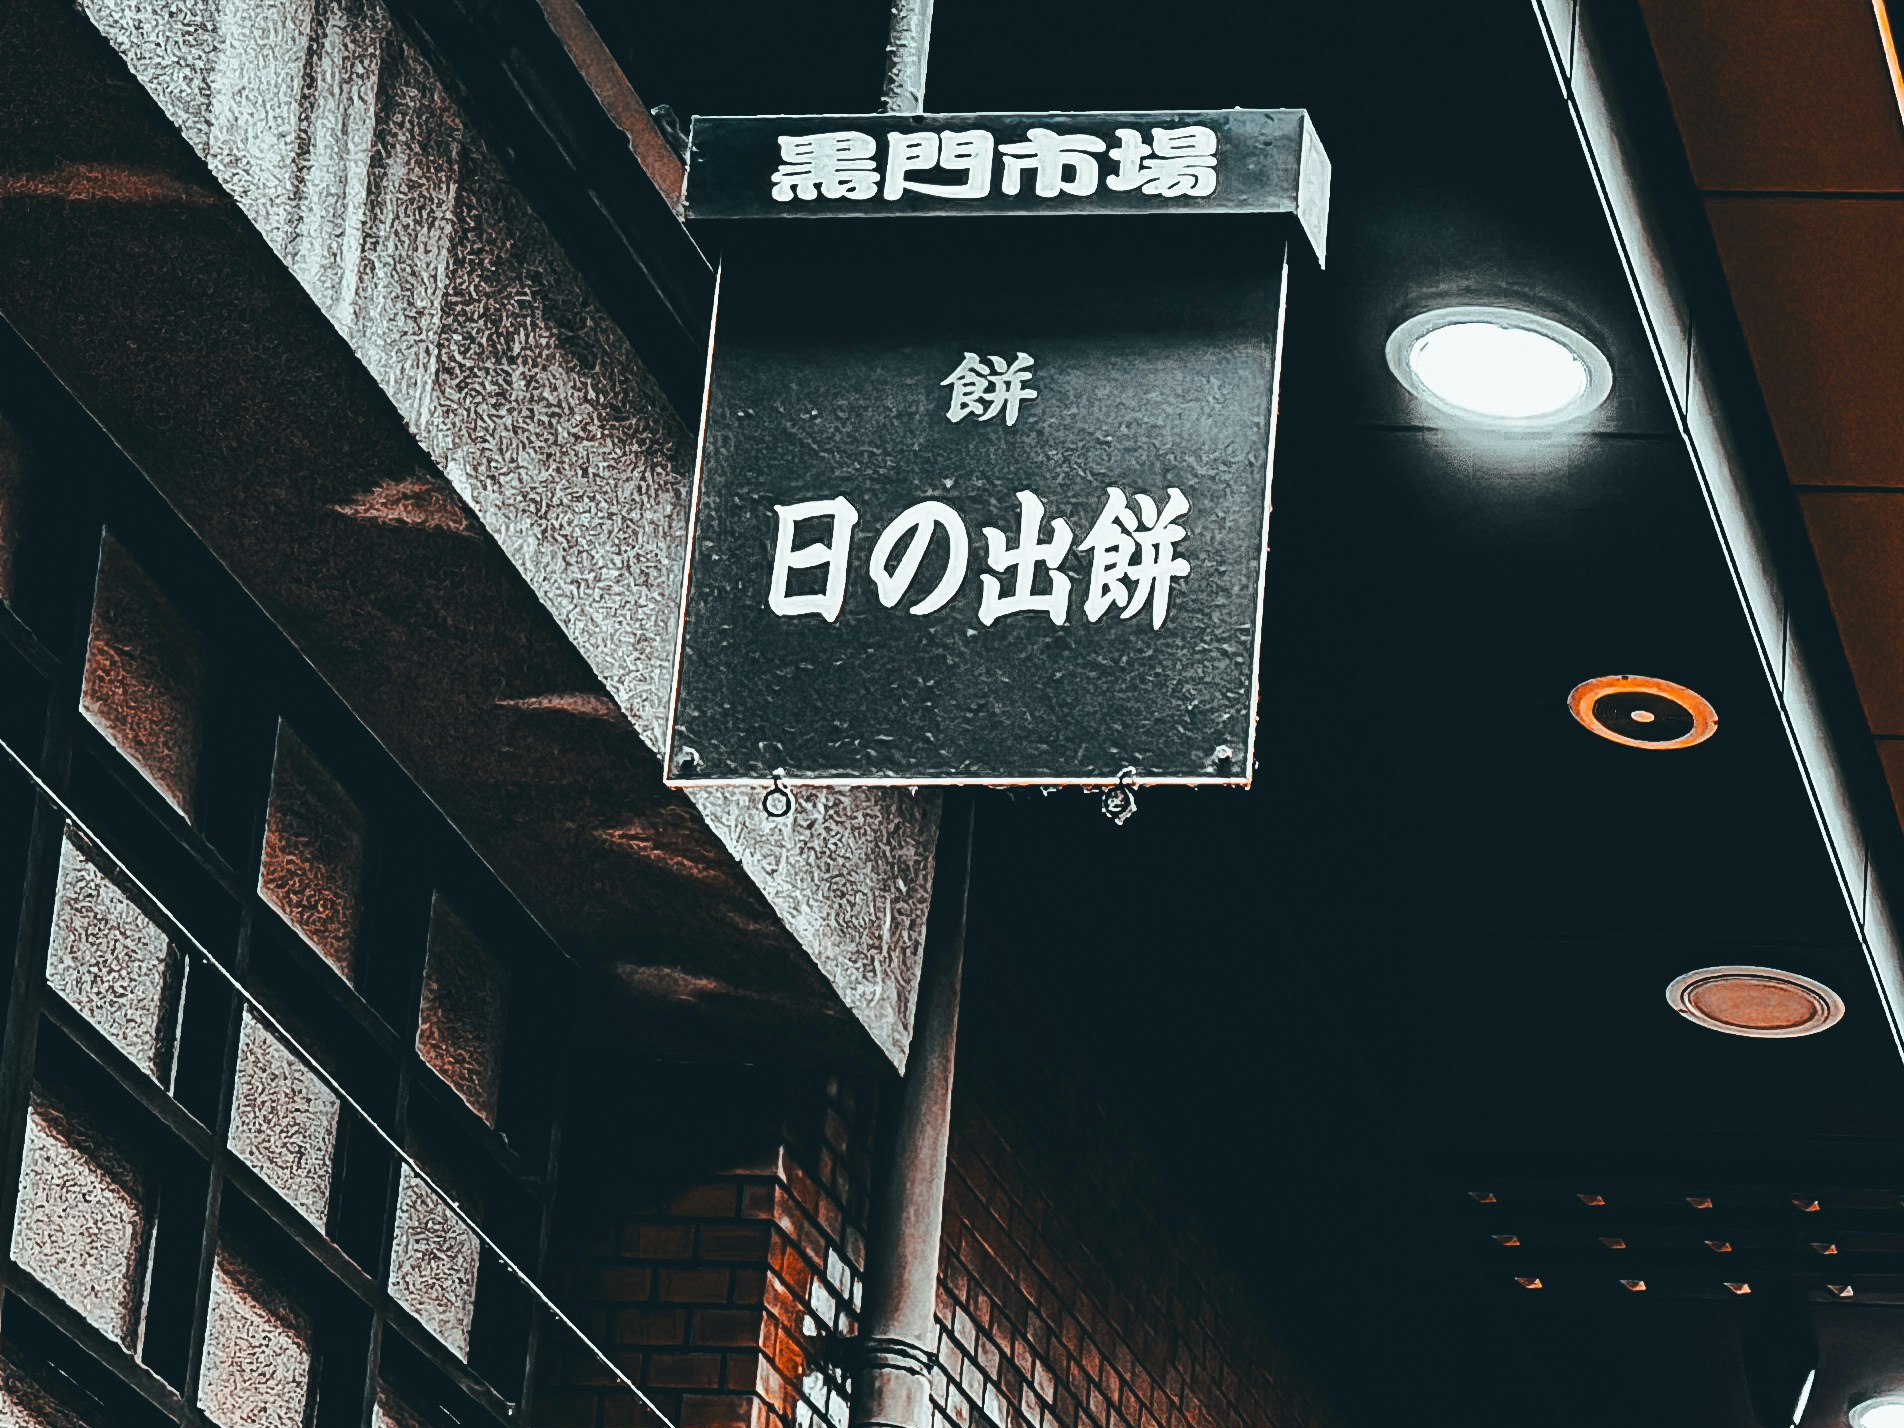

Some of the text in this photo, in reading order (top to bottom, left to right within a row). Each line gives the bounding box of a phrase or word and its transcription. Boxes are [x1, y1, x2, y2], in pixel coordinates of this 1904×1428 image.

[771, 125, 1219, 202] 黒門市場
[941, 352, 1038, 427] 餅
[767, 487, 1192, 630] 日の出餅
